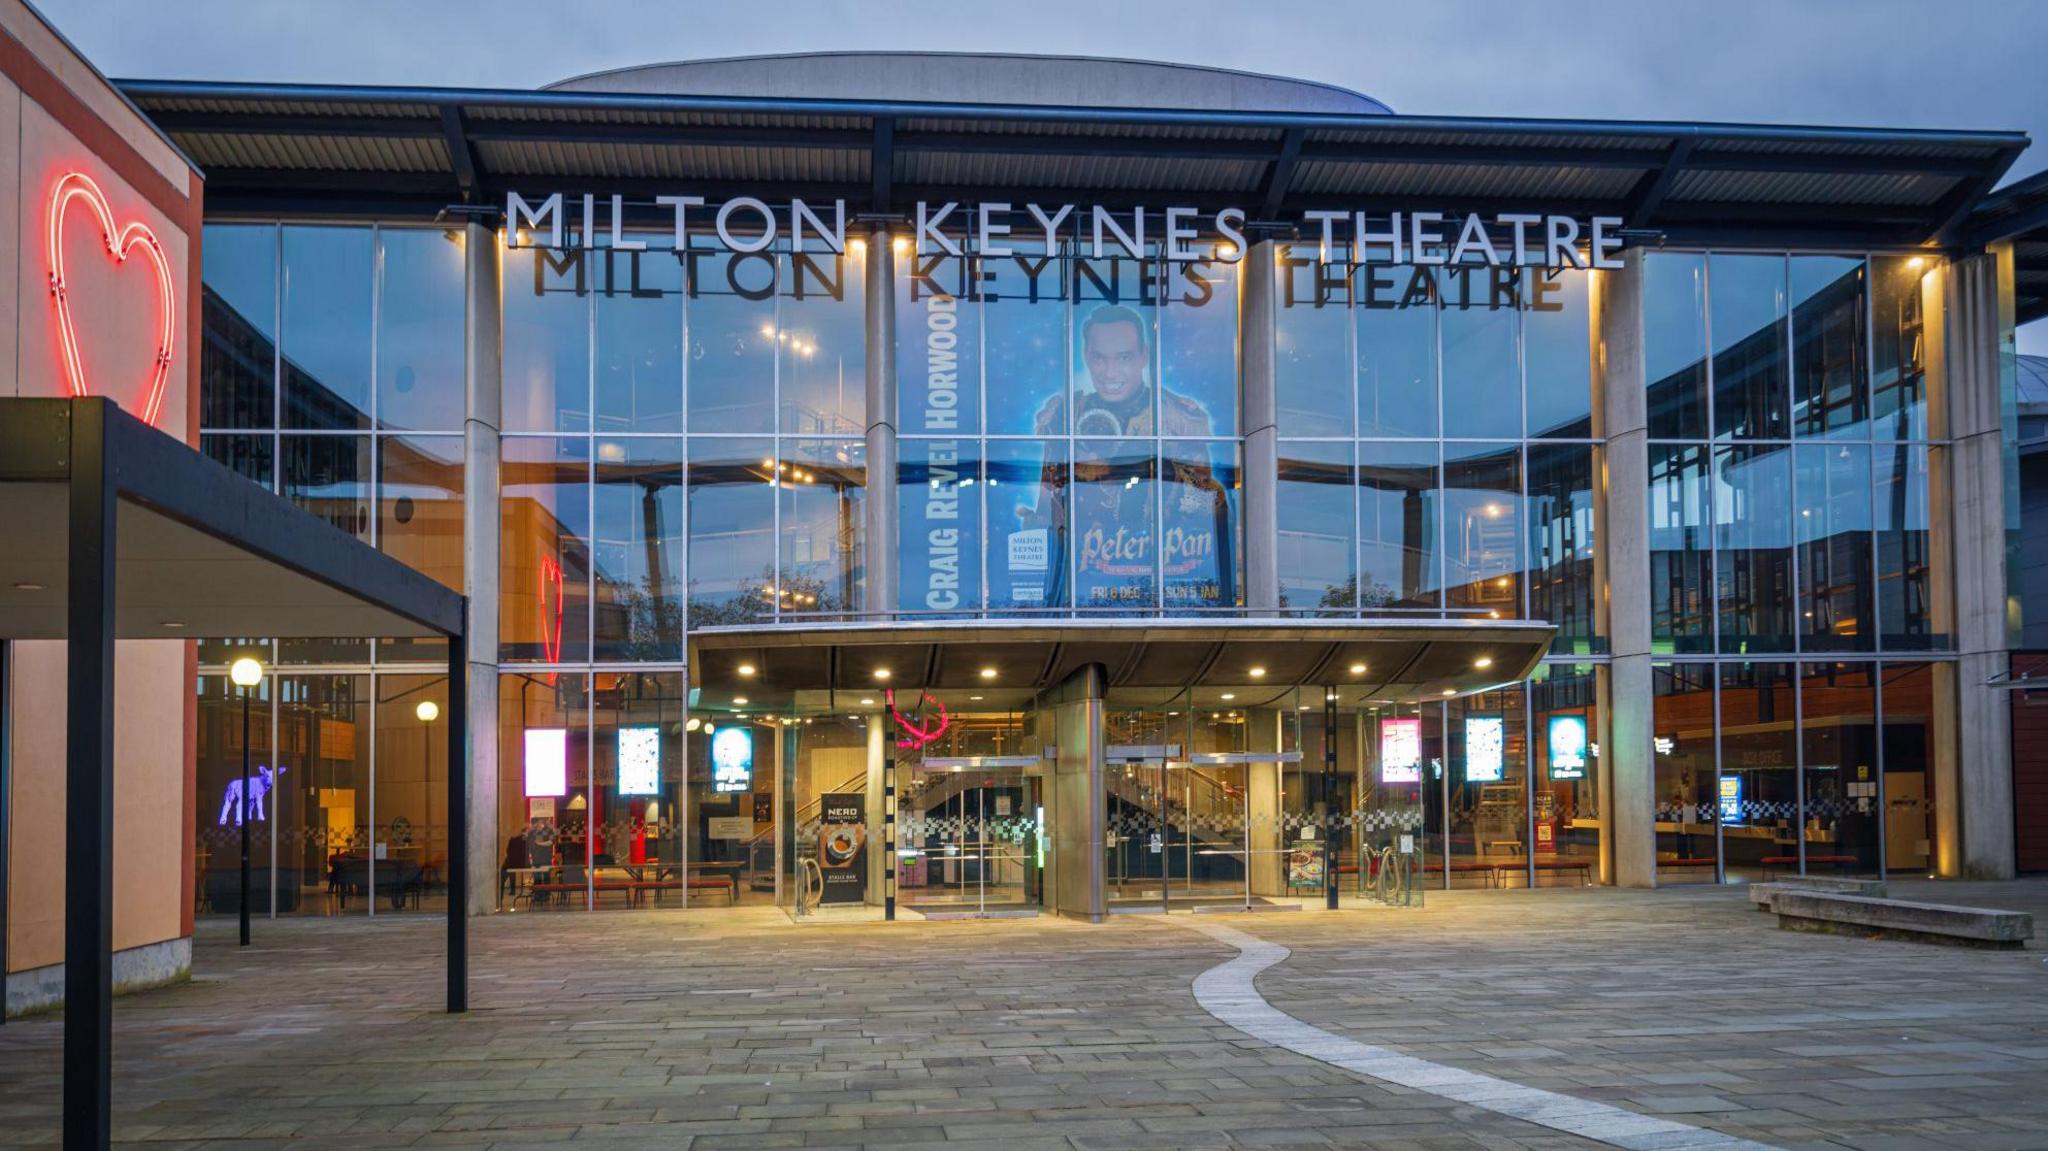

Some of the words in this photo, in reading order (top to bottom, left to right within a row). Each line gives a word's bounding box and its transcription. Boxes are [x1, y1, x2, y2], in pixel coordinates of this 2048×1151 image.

[507, 190, 845, 253] MILTON
[917, 201, 1247, 264] KEYNES
[1304, 210, 1625, 269] THEATRE
[925, 294, 958, 429] HORWOOD
[926, 440, 958, 519] REVEL
[926, 528, 959, 610] CRAIG
[1080, 525, 1150, 573] Peter
[1164, 526, 1212, 564] Pan
